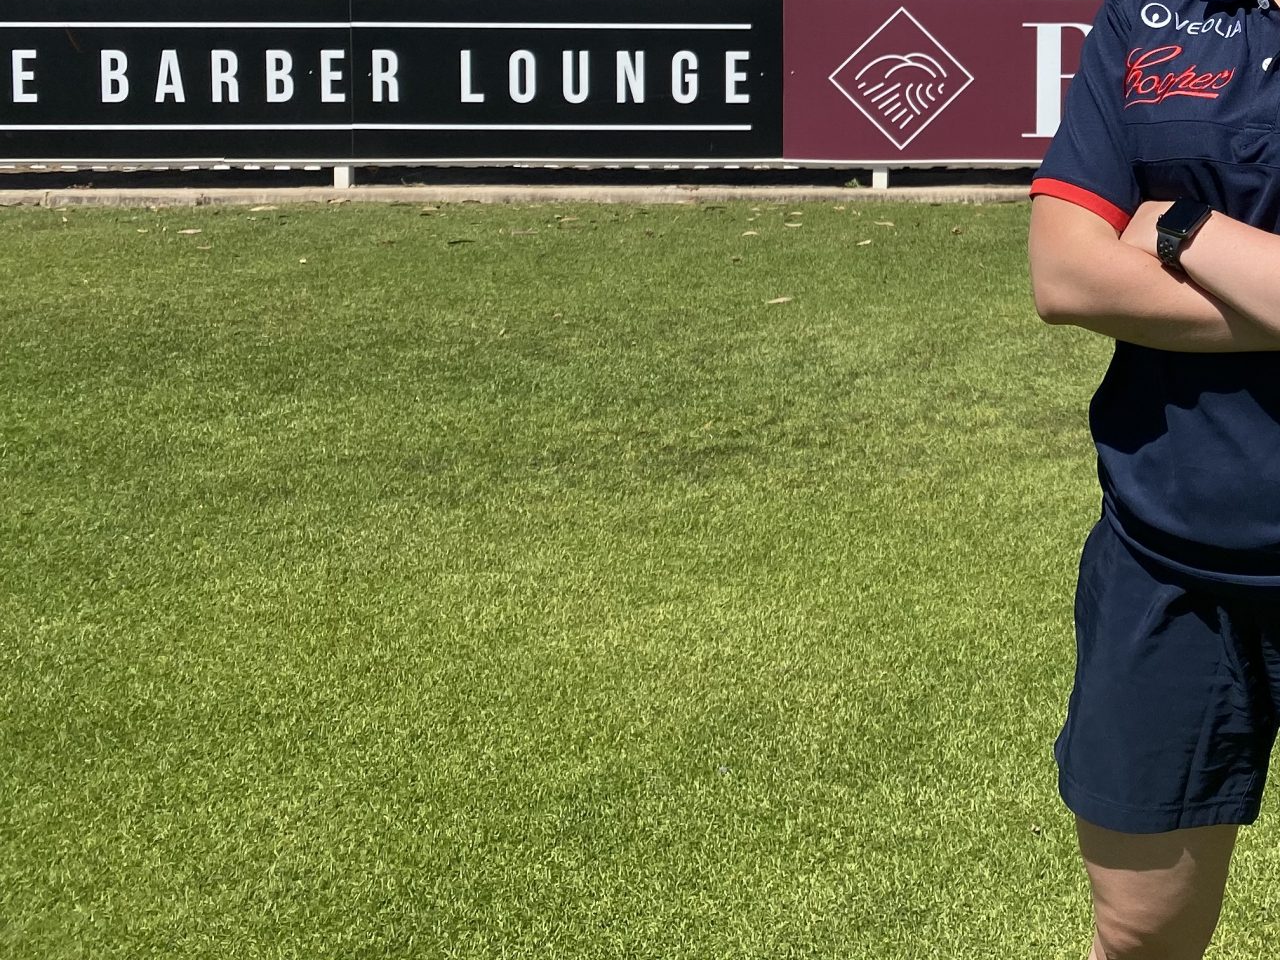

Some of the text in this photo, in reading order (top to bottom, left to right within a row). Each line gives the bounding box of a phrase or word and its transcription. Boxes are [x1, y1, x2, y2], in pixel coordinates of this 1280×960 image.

[1174, 11, 1243, 39] VEOLIA
[12, 49, 750, 104] E BARBER LOUNGE
[1124, 45, 1236, 106] Coopers
